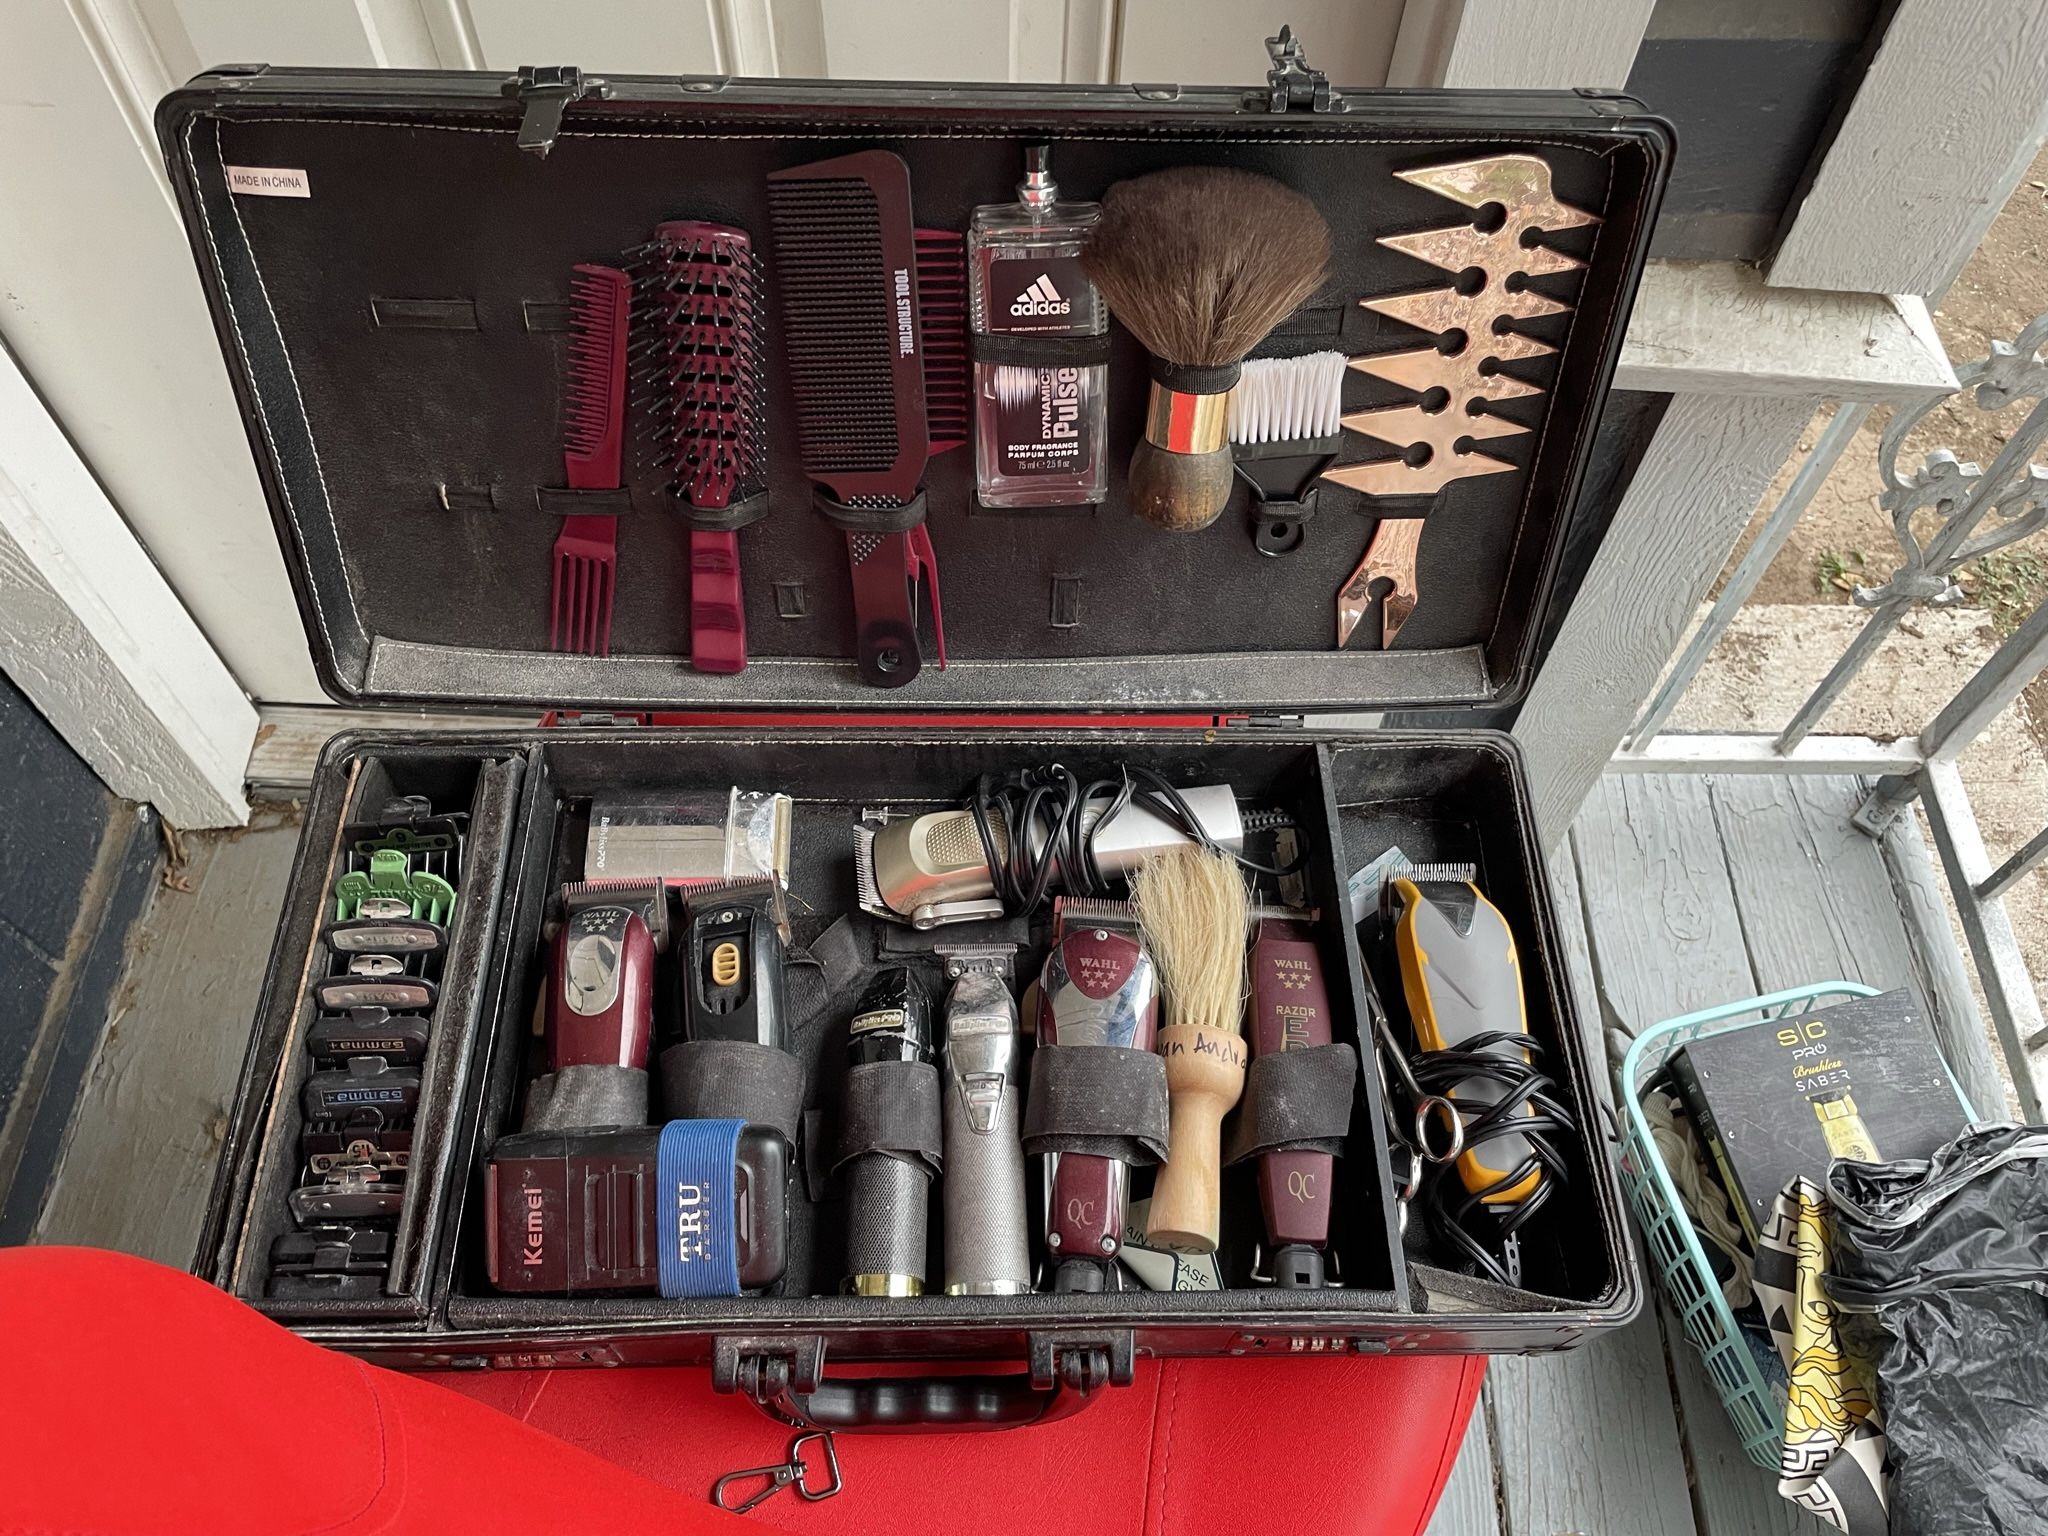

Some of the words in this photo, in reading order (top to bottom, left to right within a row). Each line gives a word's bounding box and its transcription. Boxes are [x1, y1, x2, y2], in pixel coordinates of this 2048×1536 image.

[233, 174, 260, 187] MADE
[261, 176, 271, 187] IN
[272, 176, 302, 188] CHINA
[894, 268, 910, 298] TOOL
[1010, 299, 1071, 316] adidas
[1041, 374, 1051, 439] DYNAMIC
[1052, 367, 1079, 439] Pulse
[1007, 451, 1045, 459] PARFUM
[1047, 449, 1079, 457] CORPS
[1008, 444, 1030, 452] BODY
[1031, 441, 1079, 450] FRAGRANCE
[1018, 461, 1026, 470] 75
[1027, 461, 1036, 469] ml
[1046, 460, 1056, 468] 2.5
[582, 910, 620, 919] WAHL
[1079, 957, 1121, 971] WAHL
[1274, 959, 1312, 971] WAHL
[1275, 1005, 1316, 1018] RAZOR
[1792, 1042, 1827, 1061] PRO
[1792, 1058, 1842, 1079] Brushless
[1795, 1069, 1851, 1092] SABER
[1288, 1170, 1316, 1204] QC
[679, 1182, 702, 1262] TRU
[703, 1181, 711, 1260] BARBER
[1067, 1198, 1095, 1230] QC
[523, 1187, 543, 1265] Kemei
[1177, 1258, 1210, 1288] EASE
